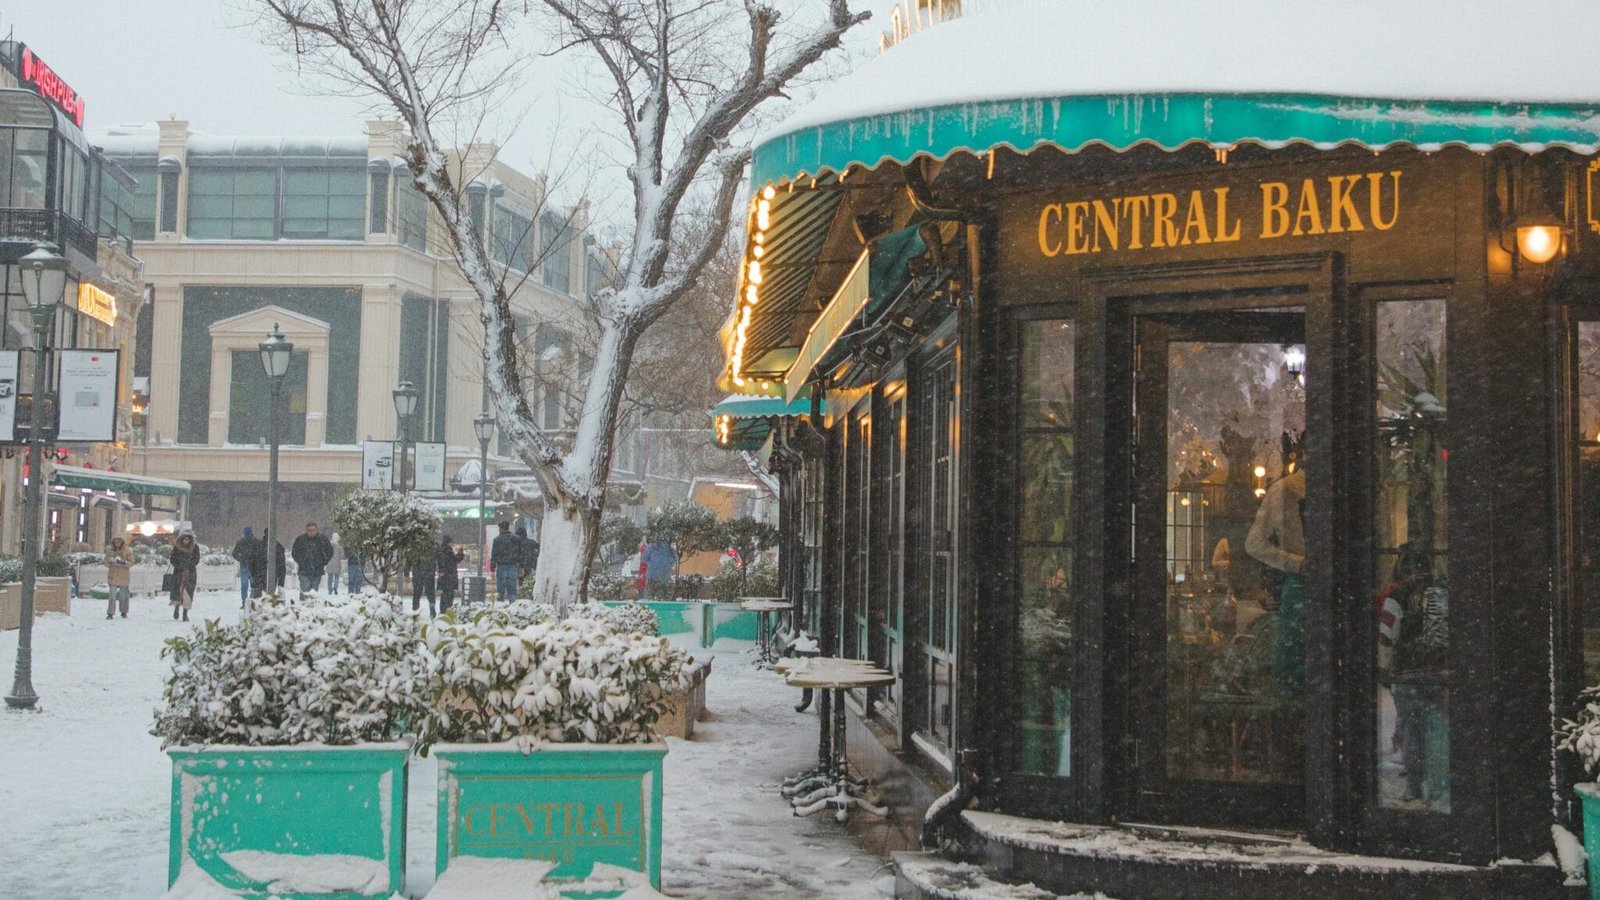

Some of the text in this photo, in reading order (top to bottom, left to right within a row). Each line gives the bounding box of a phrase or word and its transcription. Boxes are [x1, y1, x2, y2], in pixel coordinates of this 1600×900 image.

[1038, 170, 1403, 258] CENTRAL BAKU
[466, 801, 635, 839] CENTRAL
